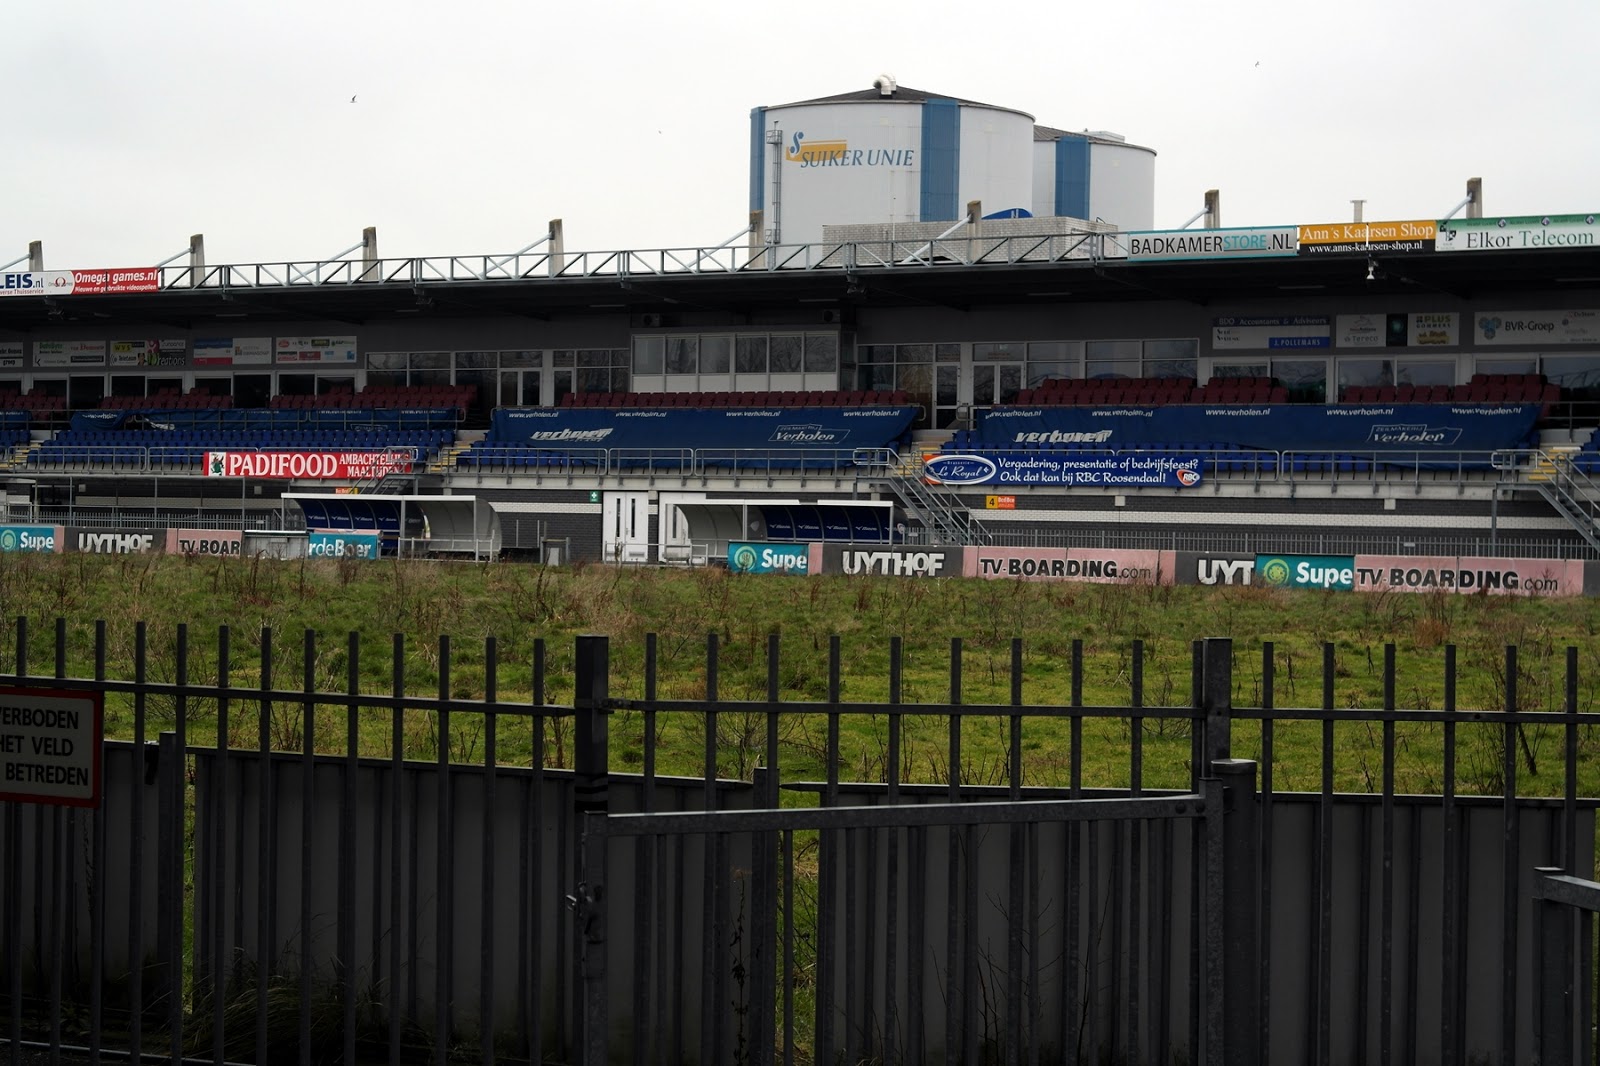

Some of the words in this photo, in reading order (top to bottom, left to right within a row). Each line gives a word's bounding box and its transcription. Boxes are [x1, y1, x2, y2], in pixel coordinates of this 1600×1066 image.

[800, 150, 863, 168] SUIKER
[867, 149, 914, 166] UNIE
[1343, 226, 1396, 239] Kaarsen
[1400, 223, 1433, 238] Shop
[1467, 231, 1513, 249] Elkor
[1518, 229, 1594, 246] Telecom
[1130, 233, 1293, 255] BADKAMERSTORE.NL
[0, 273, 44, 289] EIS.nl
[75, 271, 110, 285] Omega
[112, 269, 157, 284] games.nl
[1424, 315, 1451, 323] PLUS
[1504, 320, 1554, 333] BVR-Groep
[842, 409, 900, 417] www.verholen.nl
[1091, 408, 1153, 417] www.verholen.nl
[1205, 408, 1271, 416] www.verholen.nl
[1326, 407, 1394, 416] www.verholen.nl
[776, 430, 835, 441] Verholen
[229, 453, 338, 477] PADIFOOD
[950, 465, 983, 479] Royal
[997, 457, 1060, 471] Vergadering,
[1063, 459, 1117, 472] presentatie
[1119, 457, 1131, 473] of
[1132, 457, 1199, 473] bedrijfsfeest?
[1000, 471, 1021, 482] Ook
[1023, 470, 1040, 482] dat
[1042, 470, 1060, 482] kan
[1061, 471, 1073, 486] bij
[1075, 472, 1101, 482] RBC
[1103, 471, 1167, 483] Roosendaal!
[989, 498, 995, 506] 4
[20, 531, 55, 551] Supe
[78, 533, 153, 554] UYTHOF
[761, 548, 808, 572] Supe
[842, 551, 945, 577] UYTHOF
[980, 558, 1152, 580] TV-BOARDING.com
[1198, 559, 1255, 586] UYT
[1296, 561, 1354, 588] Supe
[1357, 568, 1559, 591] TV-BOARDING.com
[0, 706, 79, 729] ERBODEN
[32, 736, 74, 756] VELD
[6, 762, 89, 786] BETREDEN
